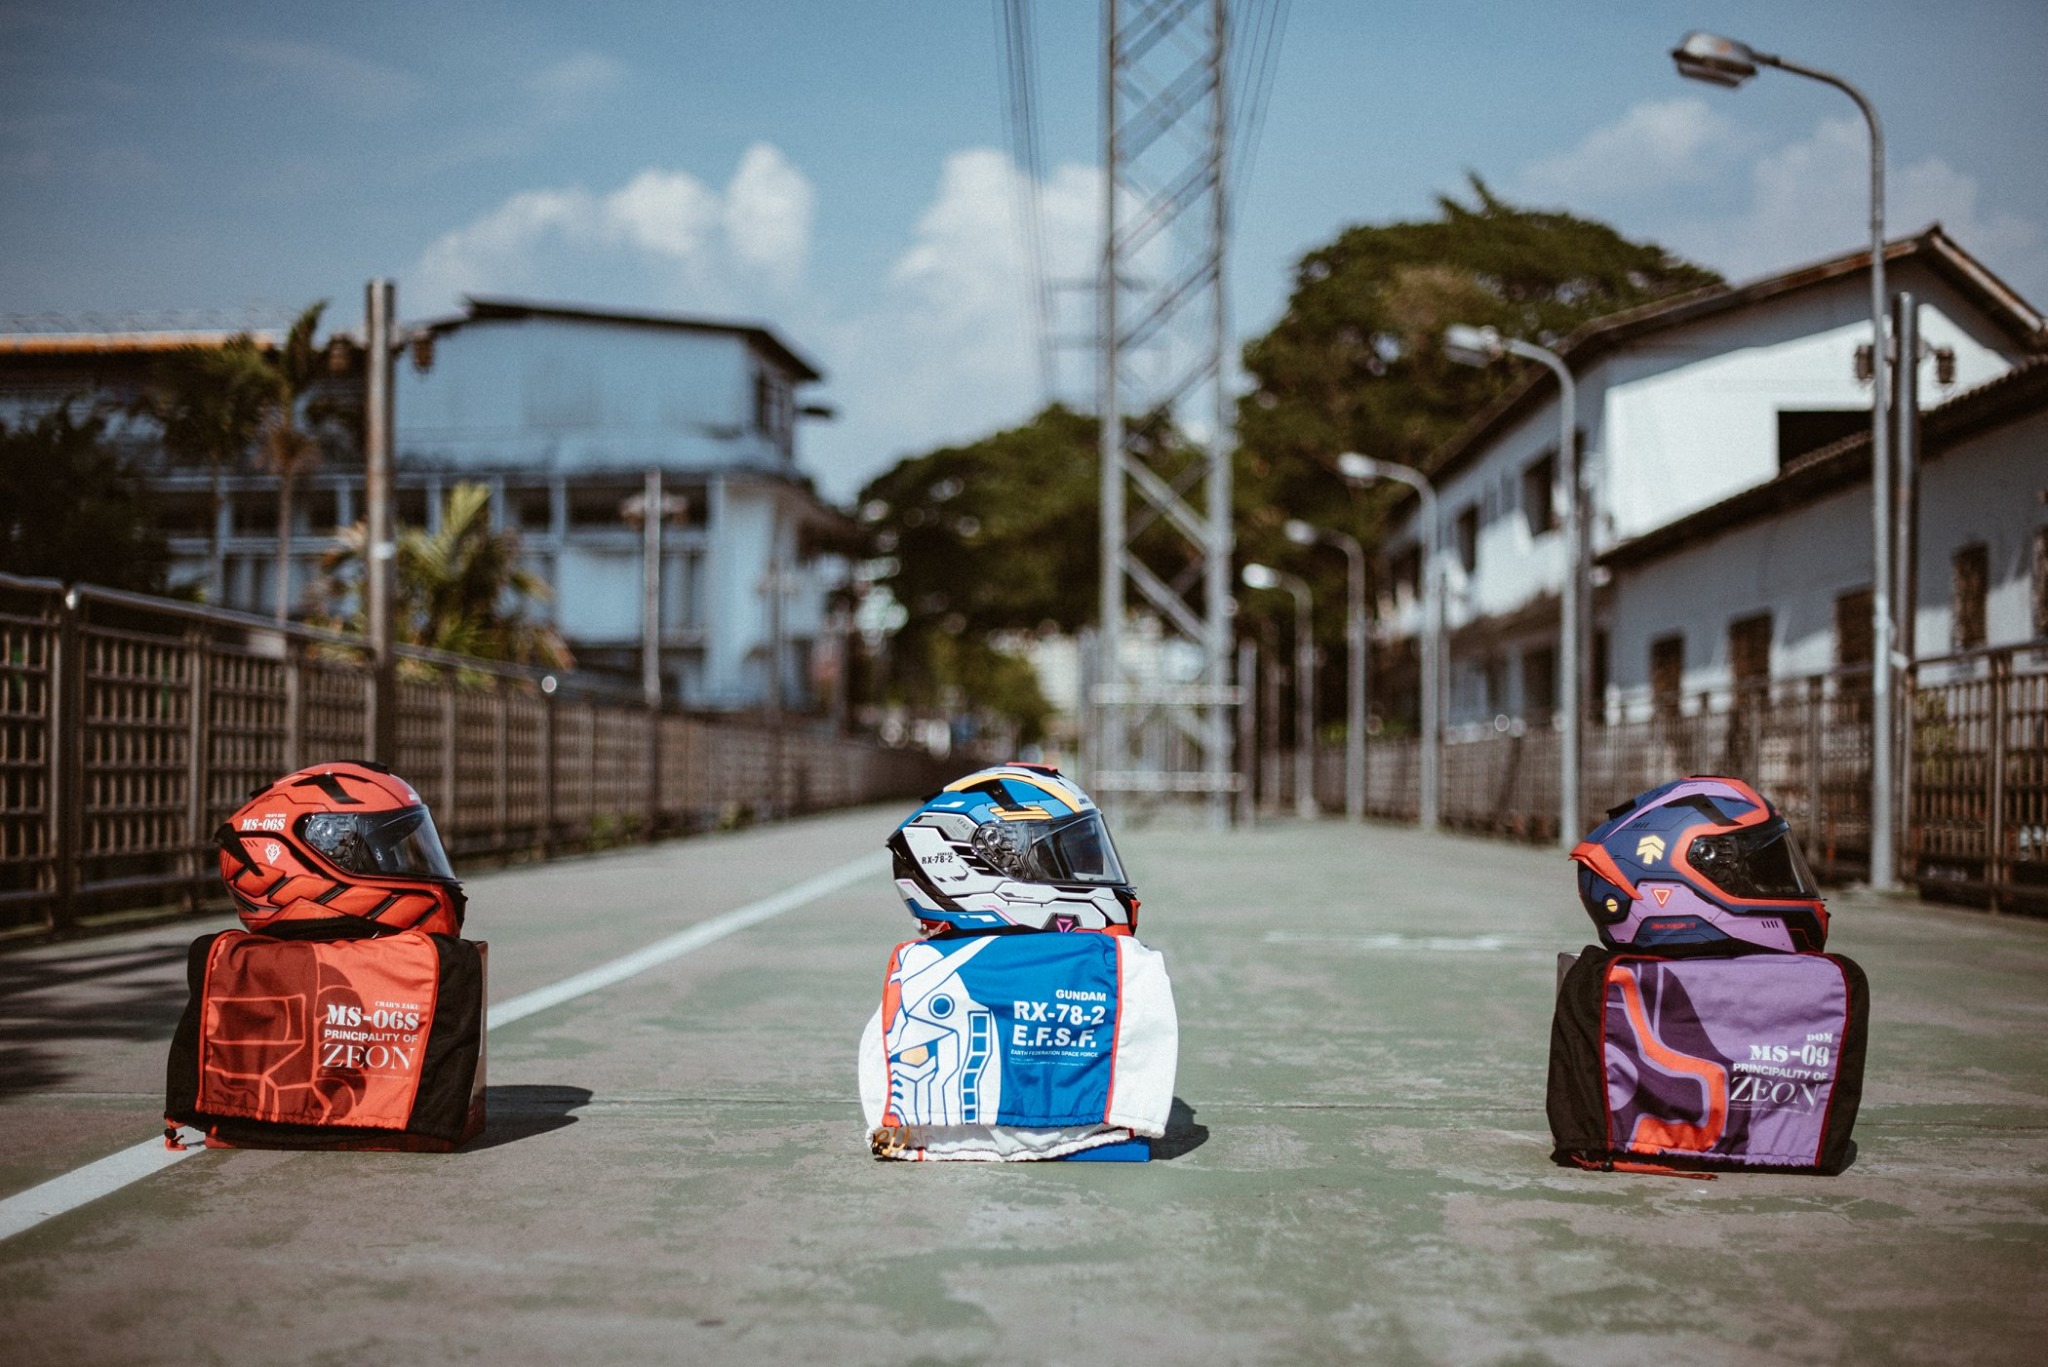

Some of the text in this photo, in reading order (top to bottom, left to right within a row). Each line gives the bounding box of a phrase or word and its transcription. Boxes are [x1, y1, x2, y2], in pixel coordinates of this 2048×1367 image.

[241, 818, 286, 831] MS-06S
[921, 855, 953, 865] RX-78-2
[1055, 989, 1107, 1002] GUNDAM
[325, 1004, 420, 1031] MS-06S
[1013, 1000, 1106, 1026] RX-78-2
[324, 1029, 418, 1043] PRINCIPALITY OF
[1012, 1024, 1097, 1048] E.F.S.F.
[1806, 1033, 1833, 1043] DOM
[322, 1043, 416, 1070] ZEON
[1749, 1044, 1830, 1068] MS-09
[1732, 1063, 1829, 1081] PRINCIPALITY OF
[1730, 1076, 1820, 1107] ZEON
